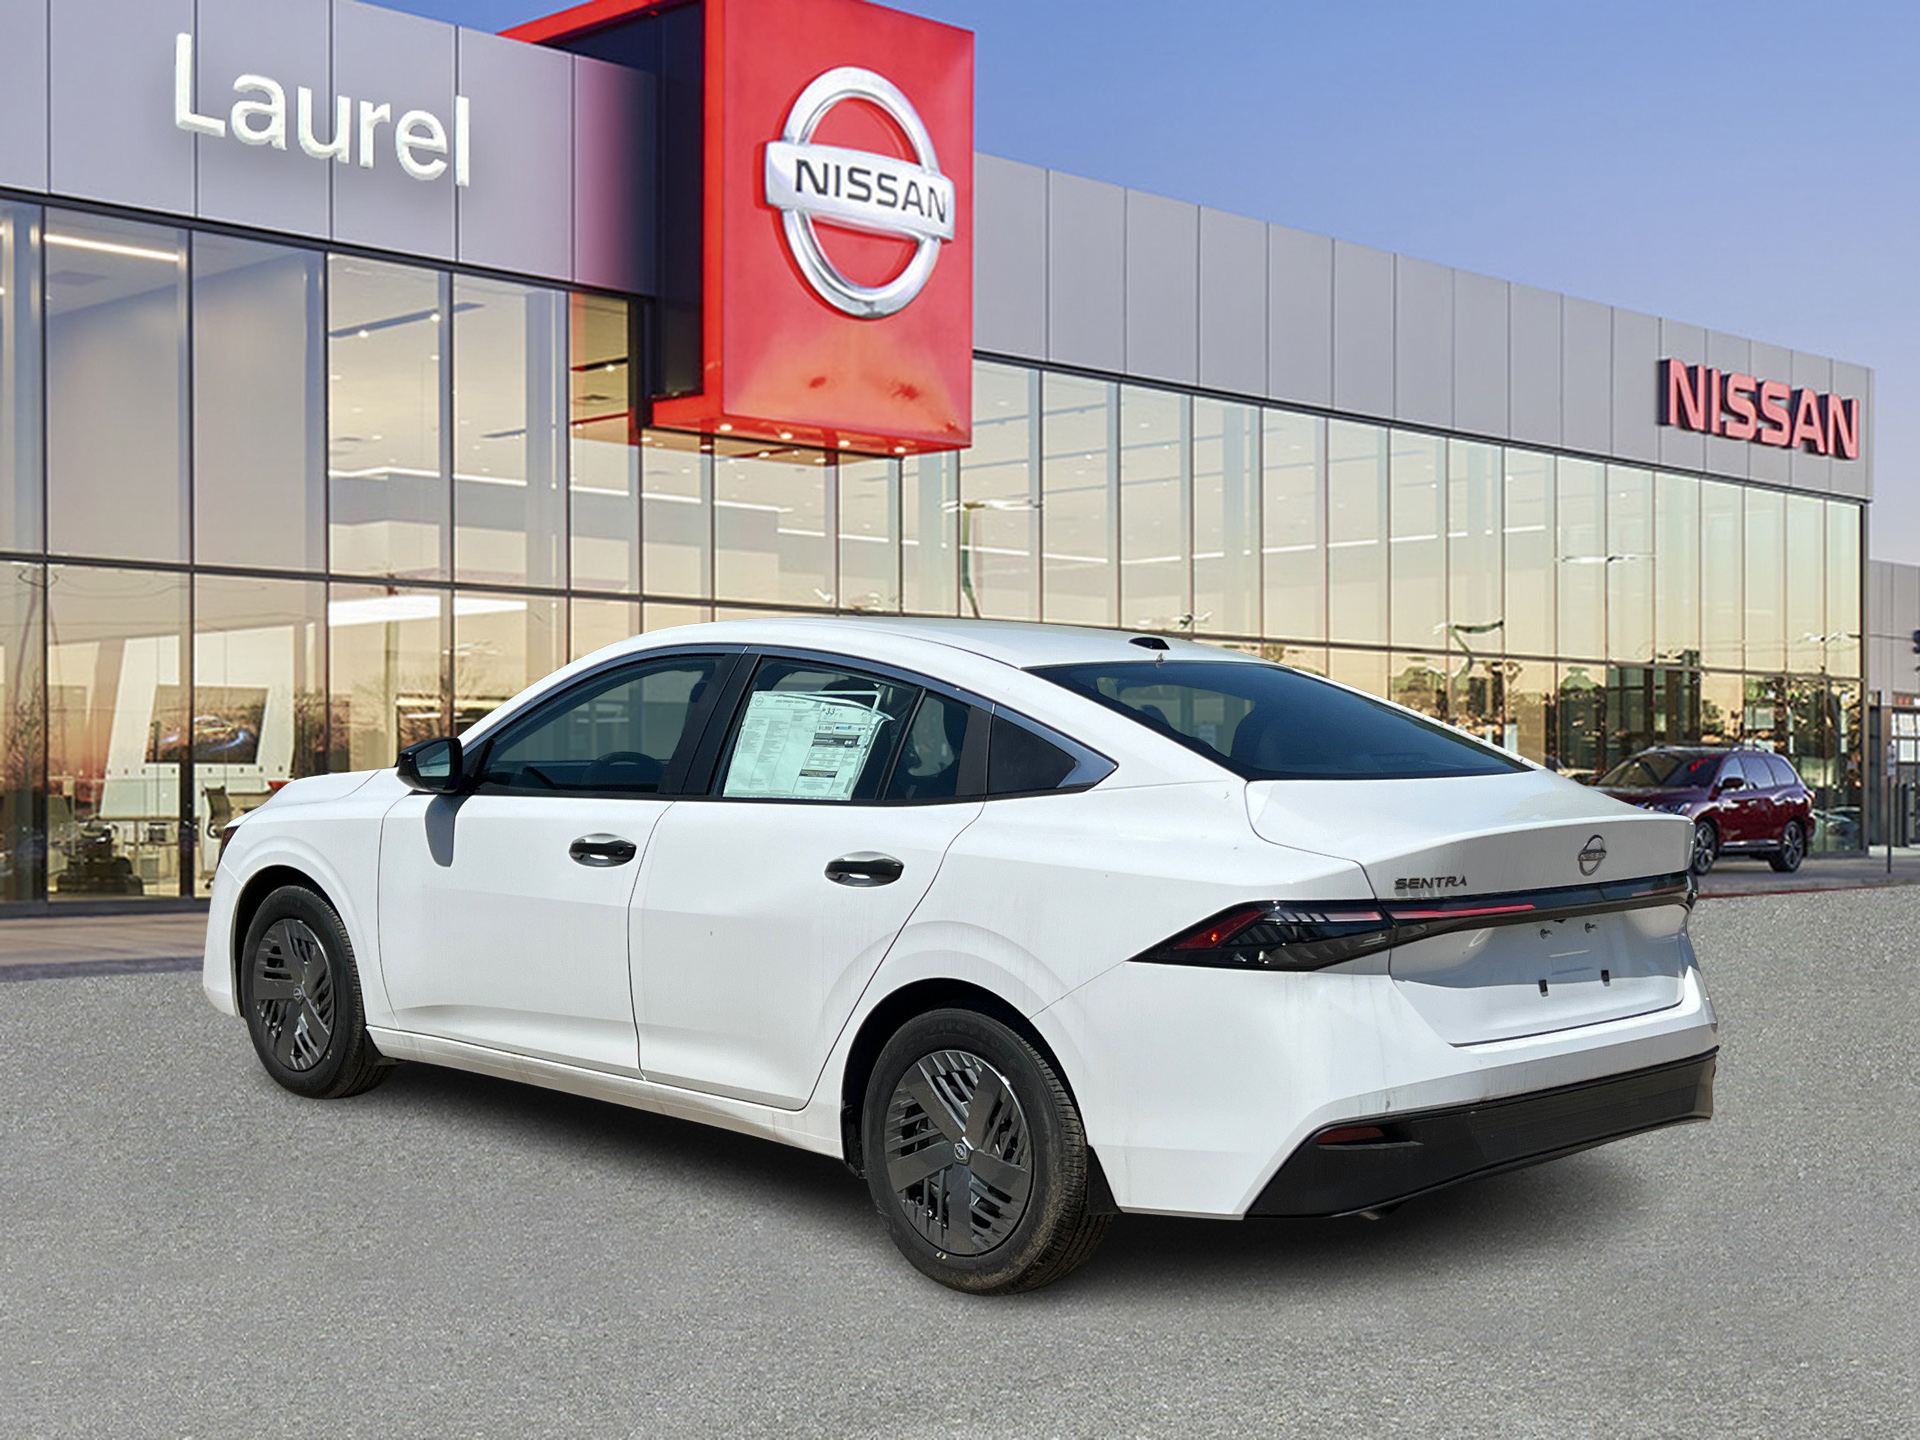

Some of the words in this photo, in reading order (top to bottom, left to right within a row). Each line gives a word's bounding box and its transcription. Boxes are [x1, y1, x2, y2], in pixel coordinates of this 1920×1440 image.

[175, 32, 470, 187] Laurel
[795, 158, 946, 223] NISSAN
[1665, 358, 1859, 459] NISSAN
[1394, 875, 1467, 890] SENTRA
